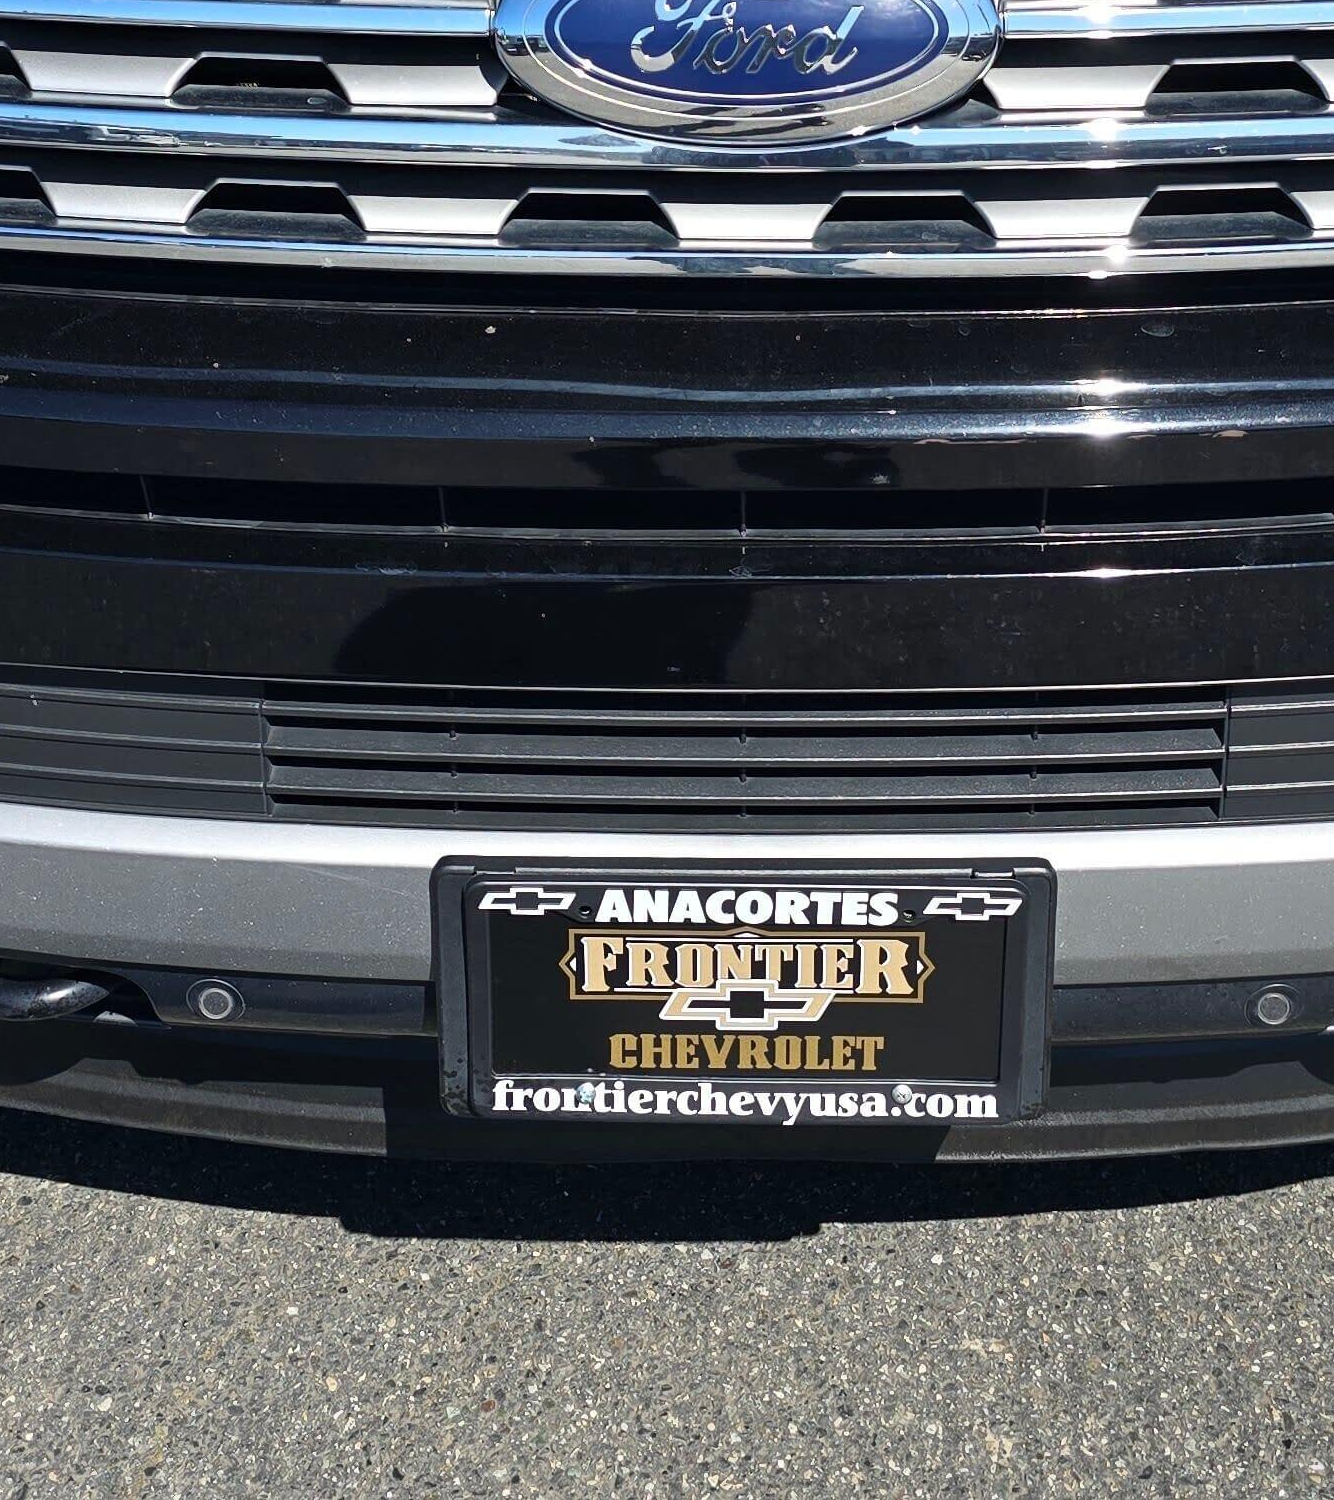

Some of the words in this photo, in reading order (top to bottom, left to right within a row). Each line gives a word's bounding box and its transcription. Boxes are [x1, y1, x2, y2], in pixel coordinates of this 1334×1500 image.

[594, 888, 900, 927] ANACORTES
[580, 935, 915, 996] FRONTIER
[608, 1032, 885, 1072] CHEVROLET
[491, 1079, 999, 1126] frontierchevyusa.com
